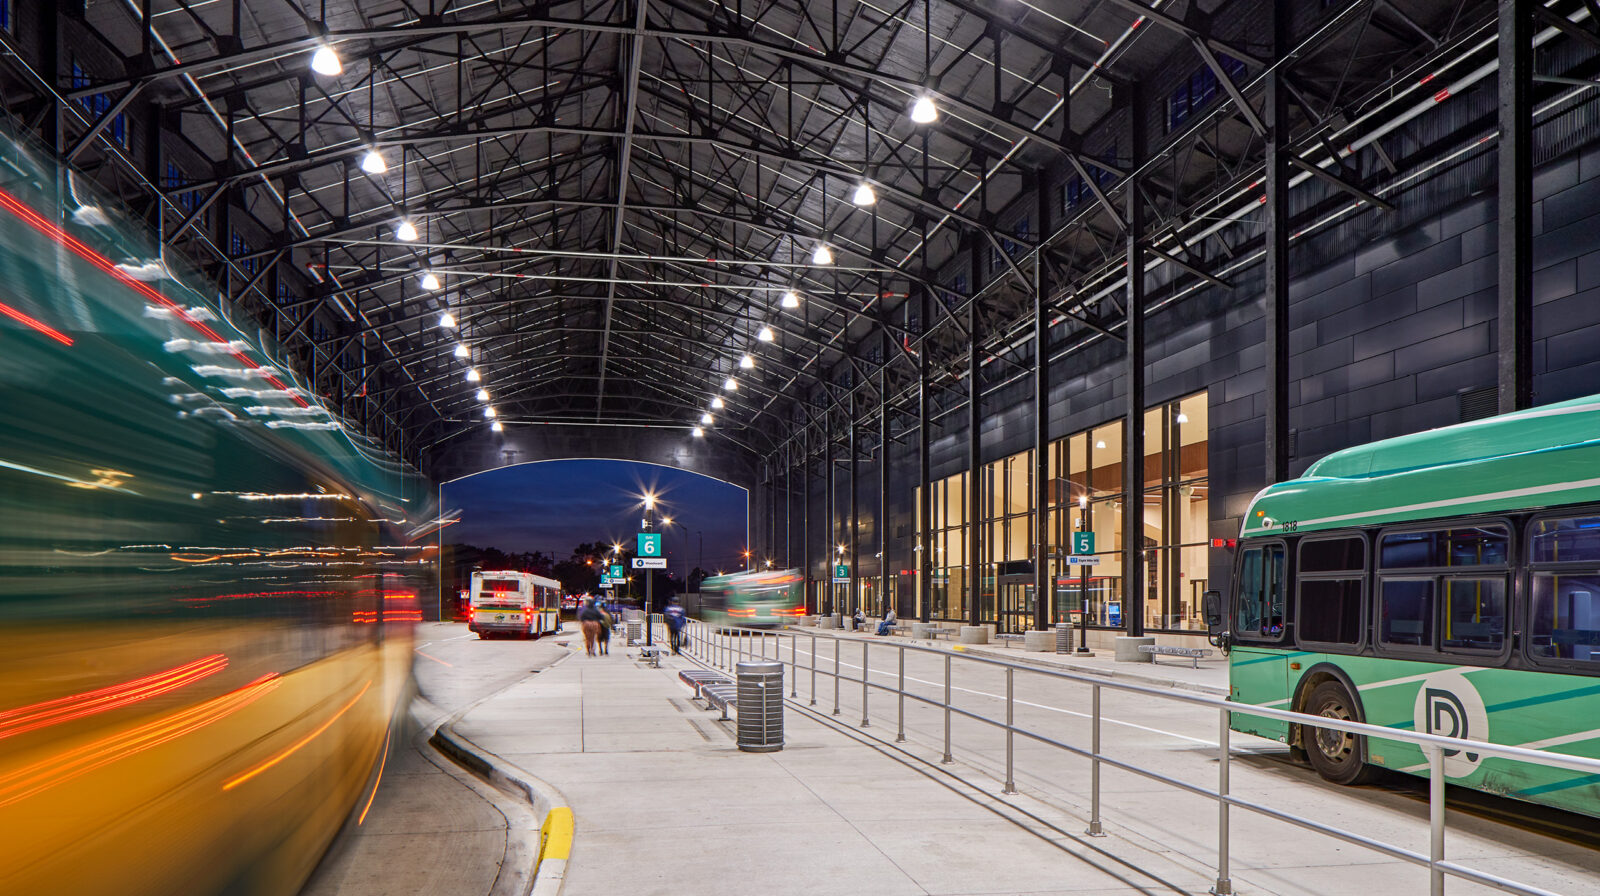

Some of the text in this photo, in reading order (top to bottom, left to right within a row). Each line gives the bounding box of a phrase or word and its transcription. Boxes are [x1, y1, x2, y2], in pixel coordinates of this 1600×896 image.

[1282, 520, 1298, 532] 1818
[644, 541, 655, 554] 6
[1080, 539, 1089, 551] 5
